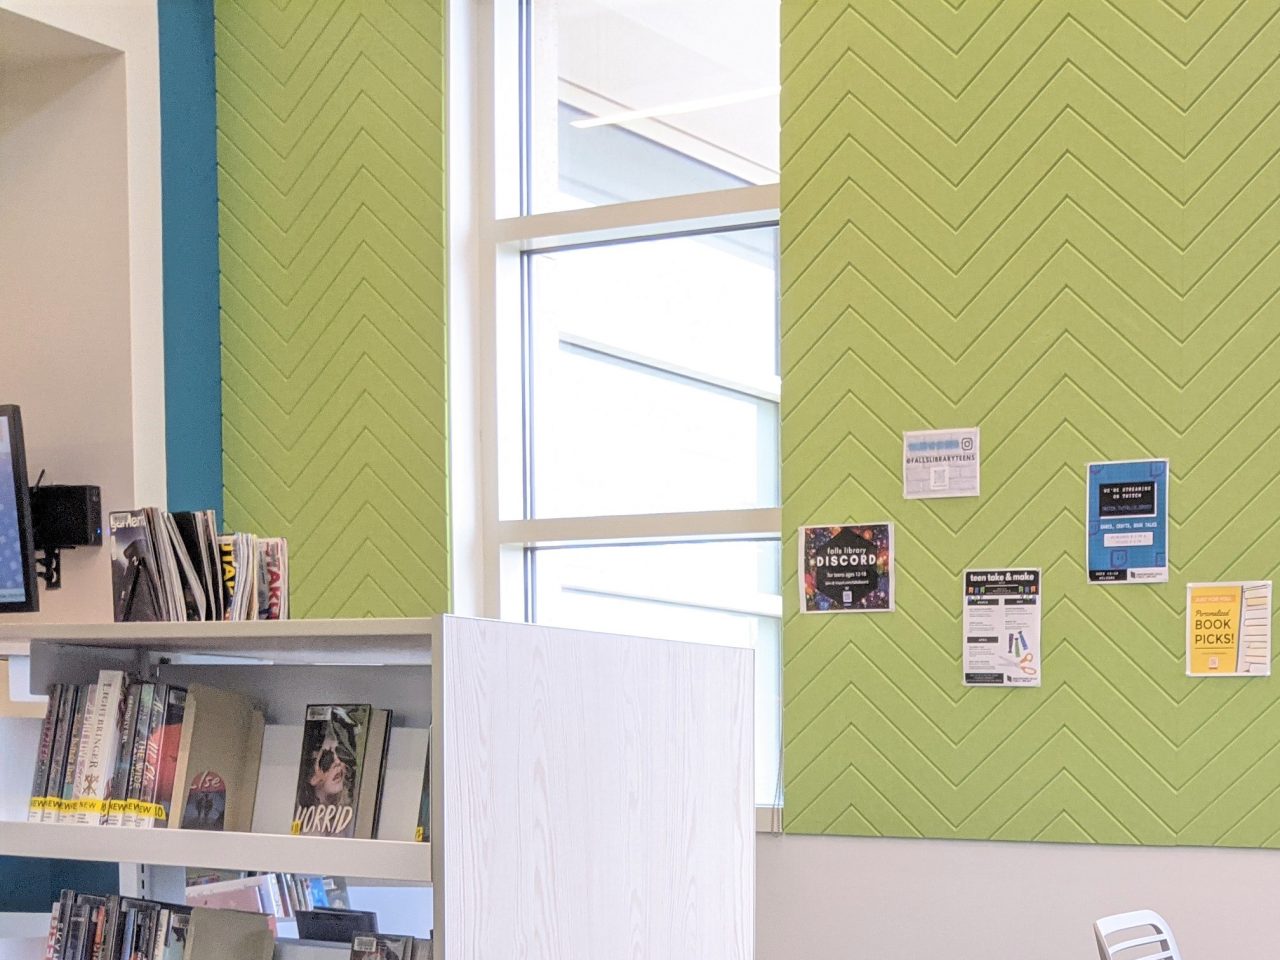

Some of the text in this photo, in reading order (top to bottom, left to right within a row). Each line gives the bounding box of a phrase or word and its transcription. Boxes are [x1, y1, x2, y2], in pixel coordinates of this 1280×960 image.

[827, 546, 867, 556] falls library
[816, 554, 877, 567] DISCORD
[970, 571, 1035, 582] teen take & make
[1195, 619, 1231, 630] BOOK
[1195, 633, 1235, 645] PICKS!
[89, 683, 112, 768] LIGHTBRINGER
